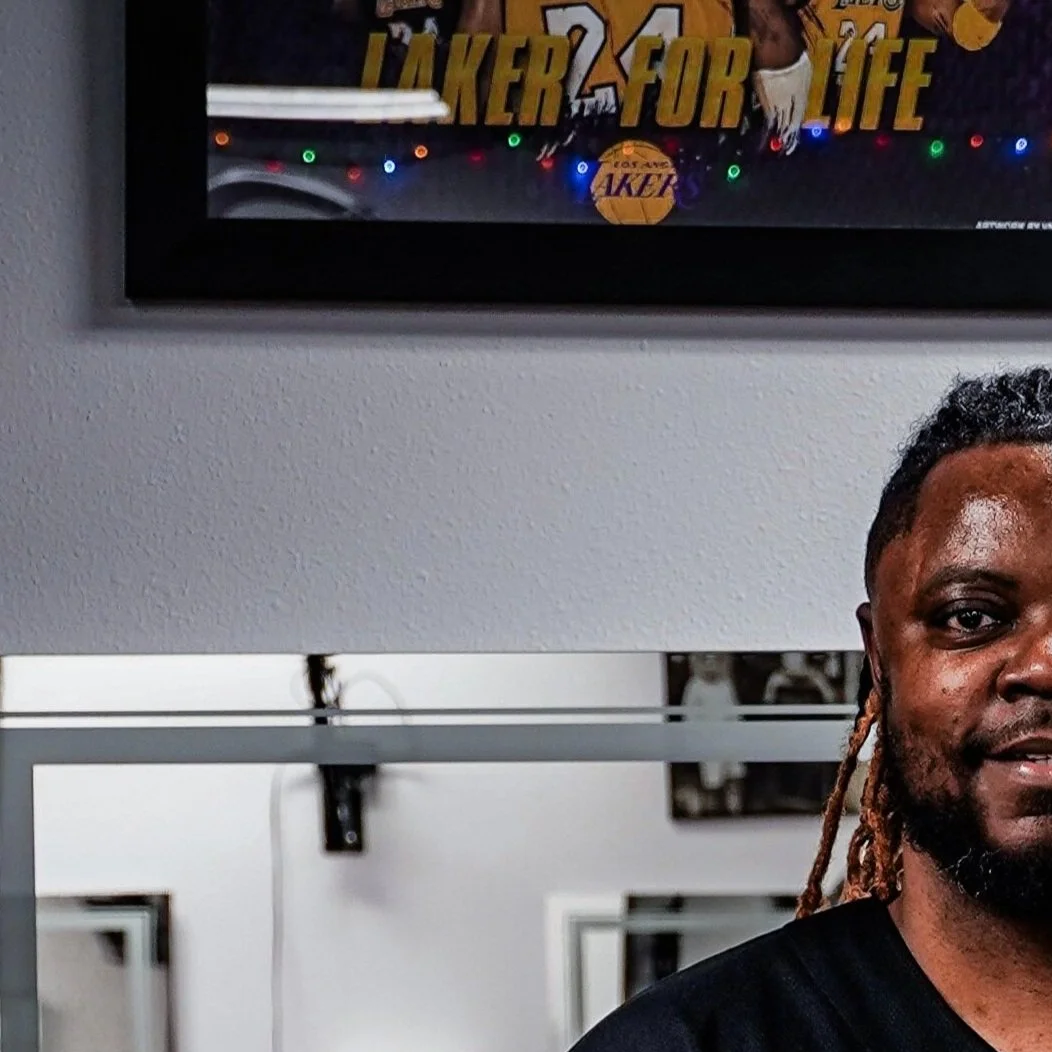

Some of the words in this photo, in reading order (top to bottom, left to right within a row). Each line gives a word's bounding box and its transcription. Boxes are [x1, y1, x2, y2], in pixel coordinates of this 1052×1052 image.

[356, 33, 572, 126] LAKER
[620, 36, 752, 128] FOR
[802, 38, 937, 131] LIFE
